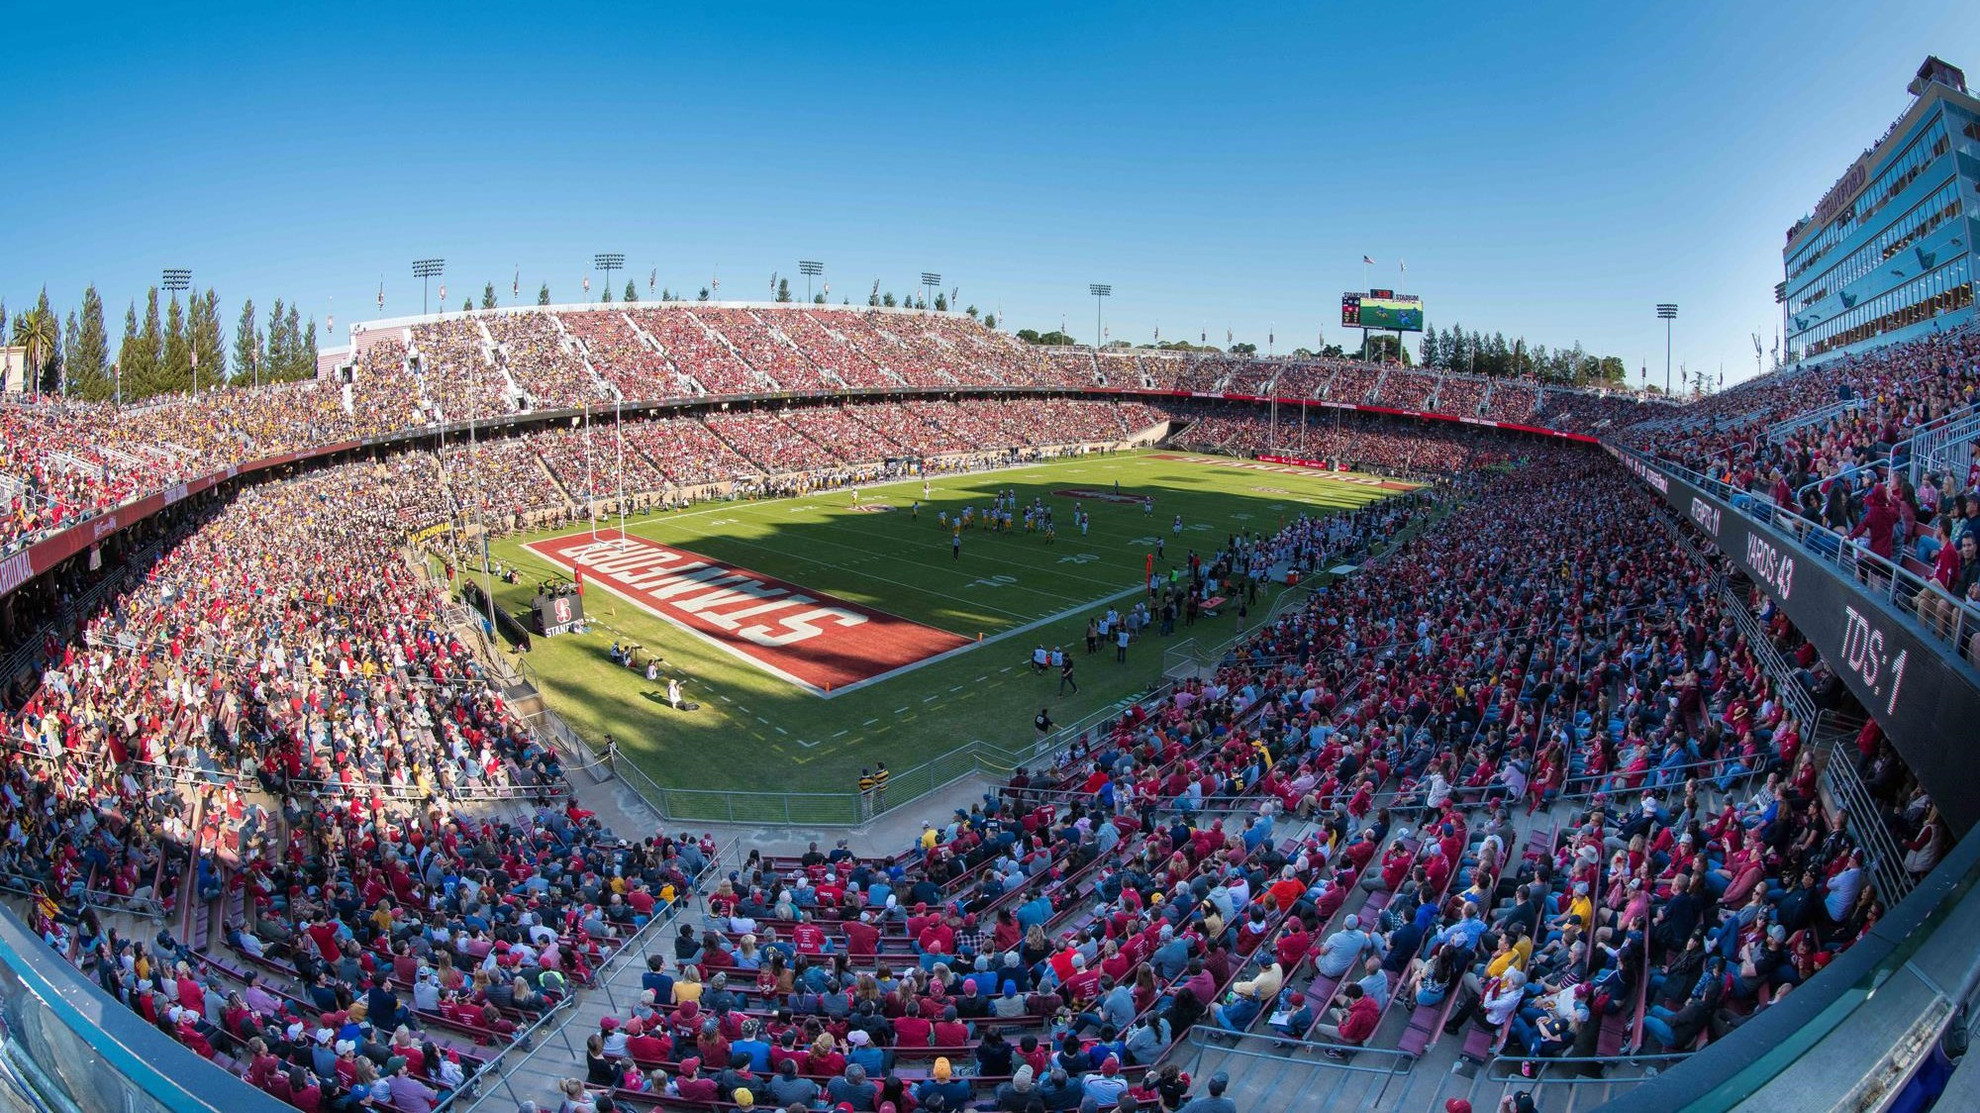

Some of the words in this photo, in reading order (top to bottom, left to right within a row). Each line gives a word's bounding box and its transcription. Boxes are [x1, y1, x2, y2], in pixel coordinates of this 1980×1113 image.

[1820, 164, 1866, 224] STANFORD
[411, 522, 450, 542] ALIFORNIA
[1712, 509, 1721, 537] 11
[0, 551, 34, 595] RDINAL
[976, 575, 1018, 587] 10
[1746, 532, 1779, 586] YARDS:
[1777, 555, 1794, 600] 43
[557, 538, 868, 646] STANFORD
[1842, 606, 1887, 696] TDS:
[1887, 650, 1907, 715] 1
[1235, 780, 1244, 791] 16
